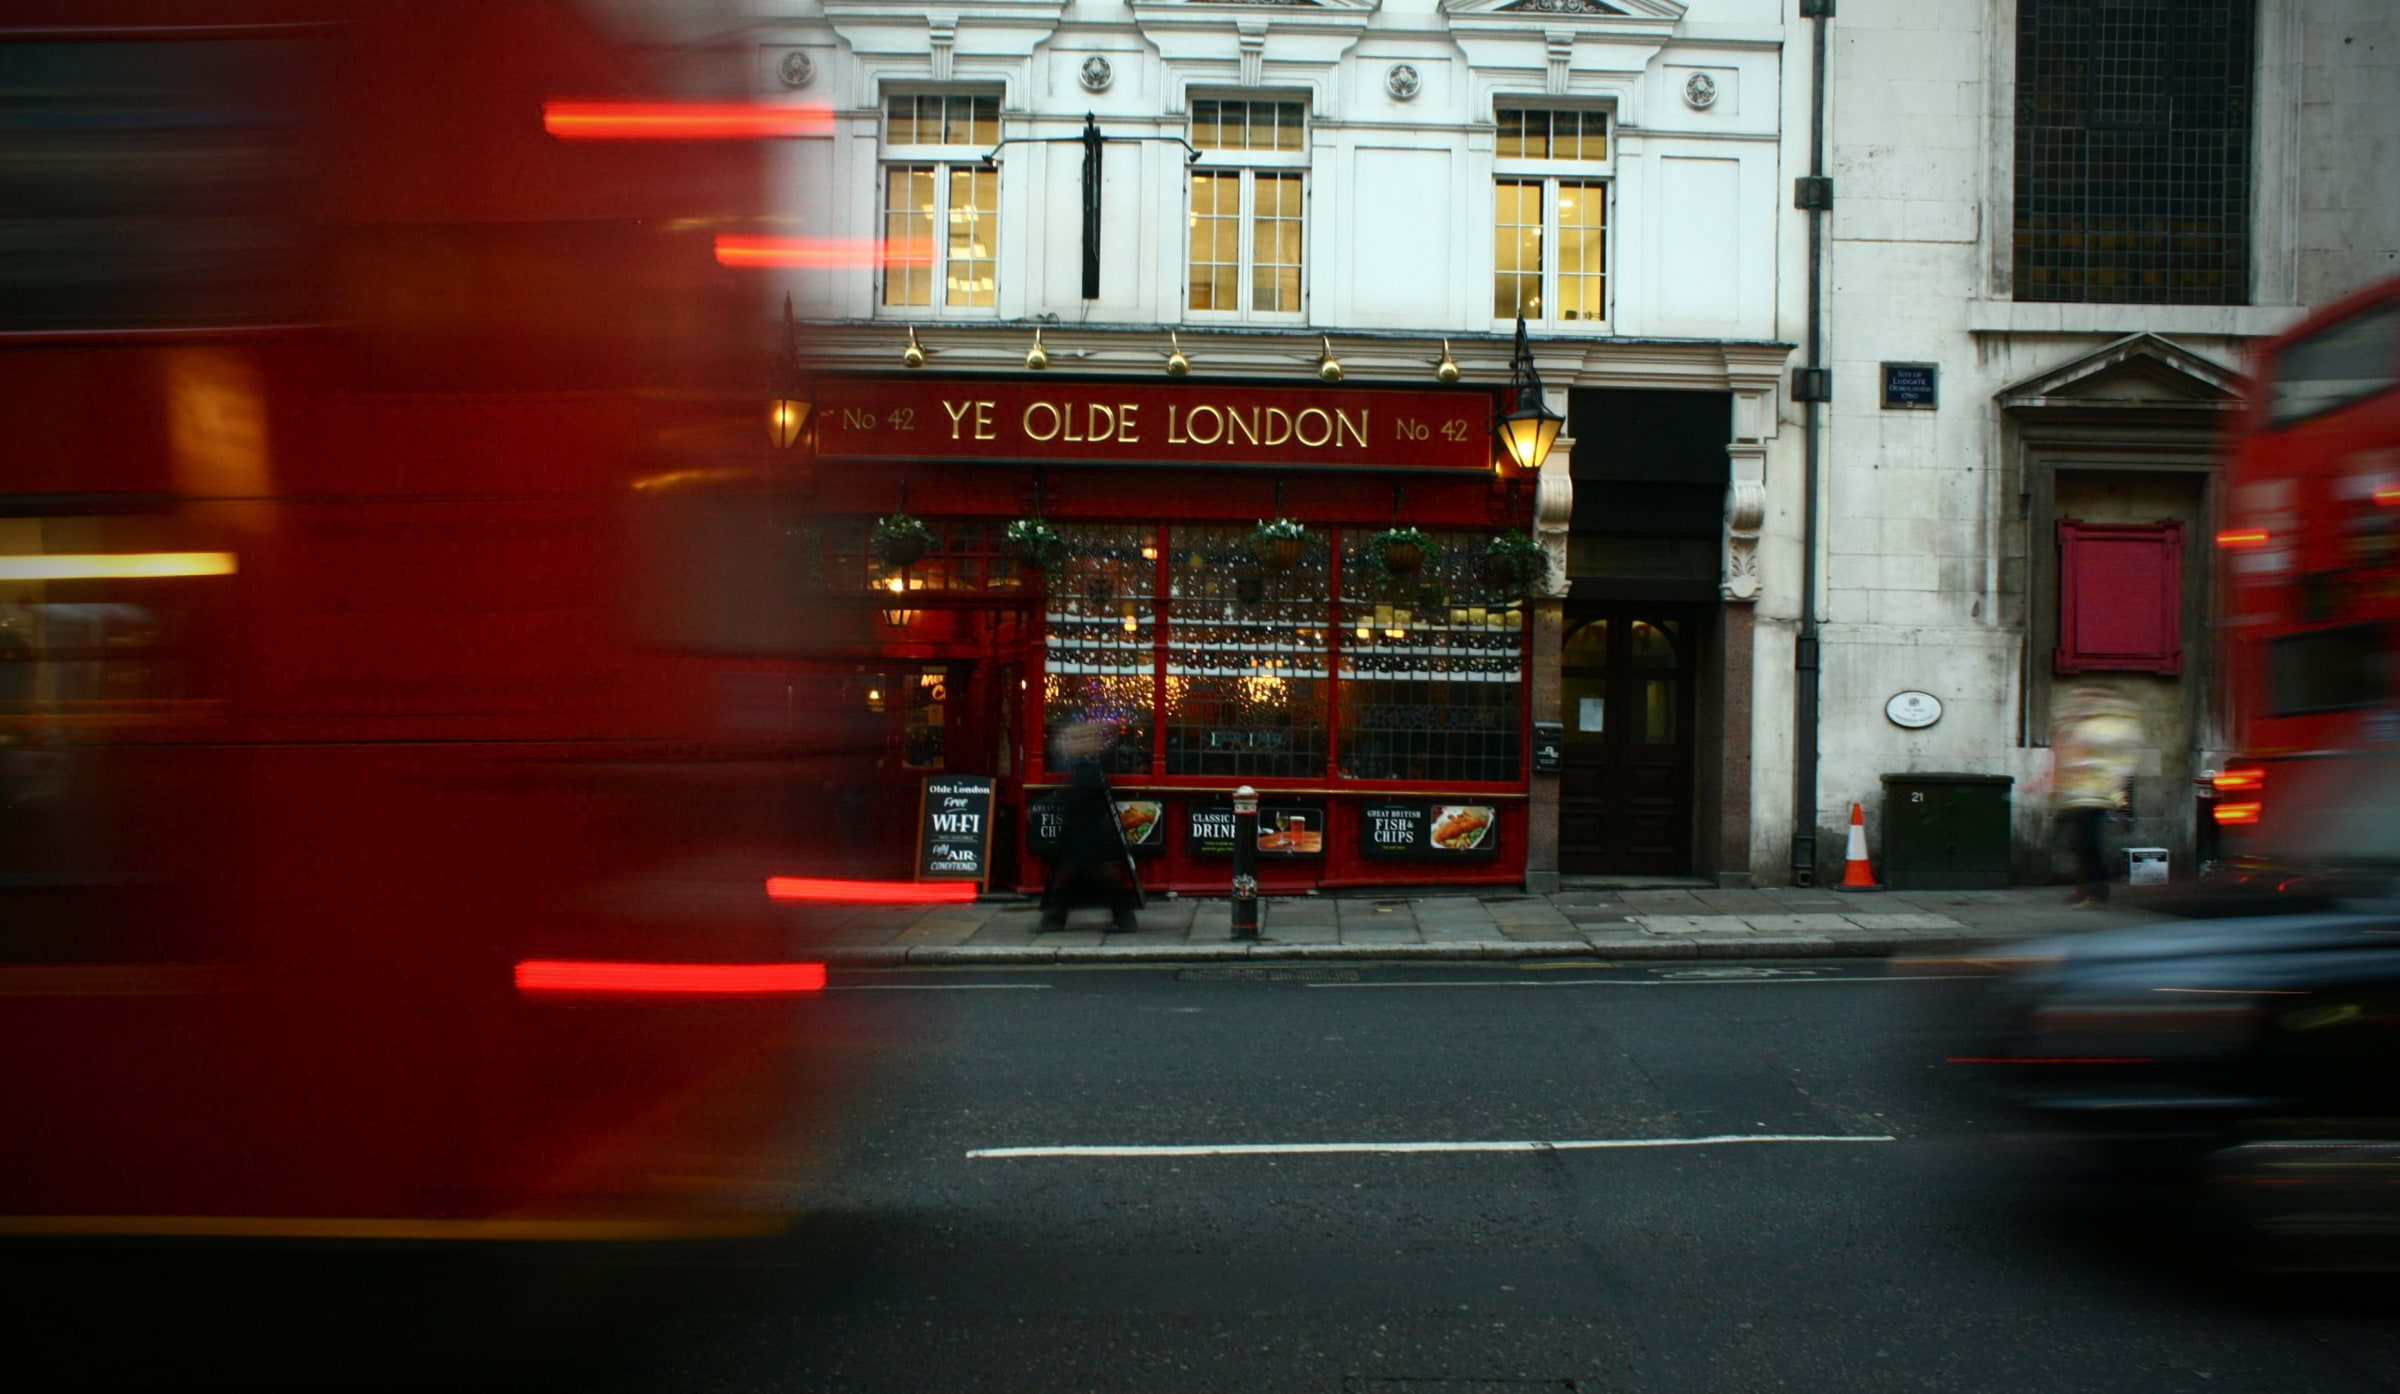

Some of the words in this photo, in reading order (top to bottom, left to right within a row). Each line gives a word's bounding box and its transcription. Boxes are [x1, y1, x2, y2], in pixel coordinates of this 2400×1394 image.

[843, 409, 876, 430] No
[887, 408, 915, 431] 42
[942, 400, 997, 440] YE
[1022, 402, 1140, 443] OLDE
[1167, 404, 1369, 448] LONDON
[1396, 418, 1430, 441] No
[1440, 419, 1468, 442] 42
[929, 785, 953, 794] Olde
[953, 785, 991, 795] London
[1911, 791, 1924, 802] 21
[943, 796, 969, 808] Free
[932, 813, 980, 833] WI-FI
[1041, 813, 1064, 825] FIS
[1192, 813, 1231, 824] CLASSIC
[1375, 818, 1406, 831] FISH
[1192, 823, 1236, 839] DRIN
[1374, 830, 1414, 844] CHIPS
